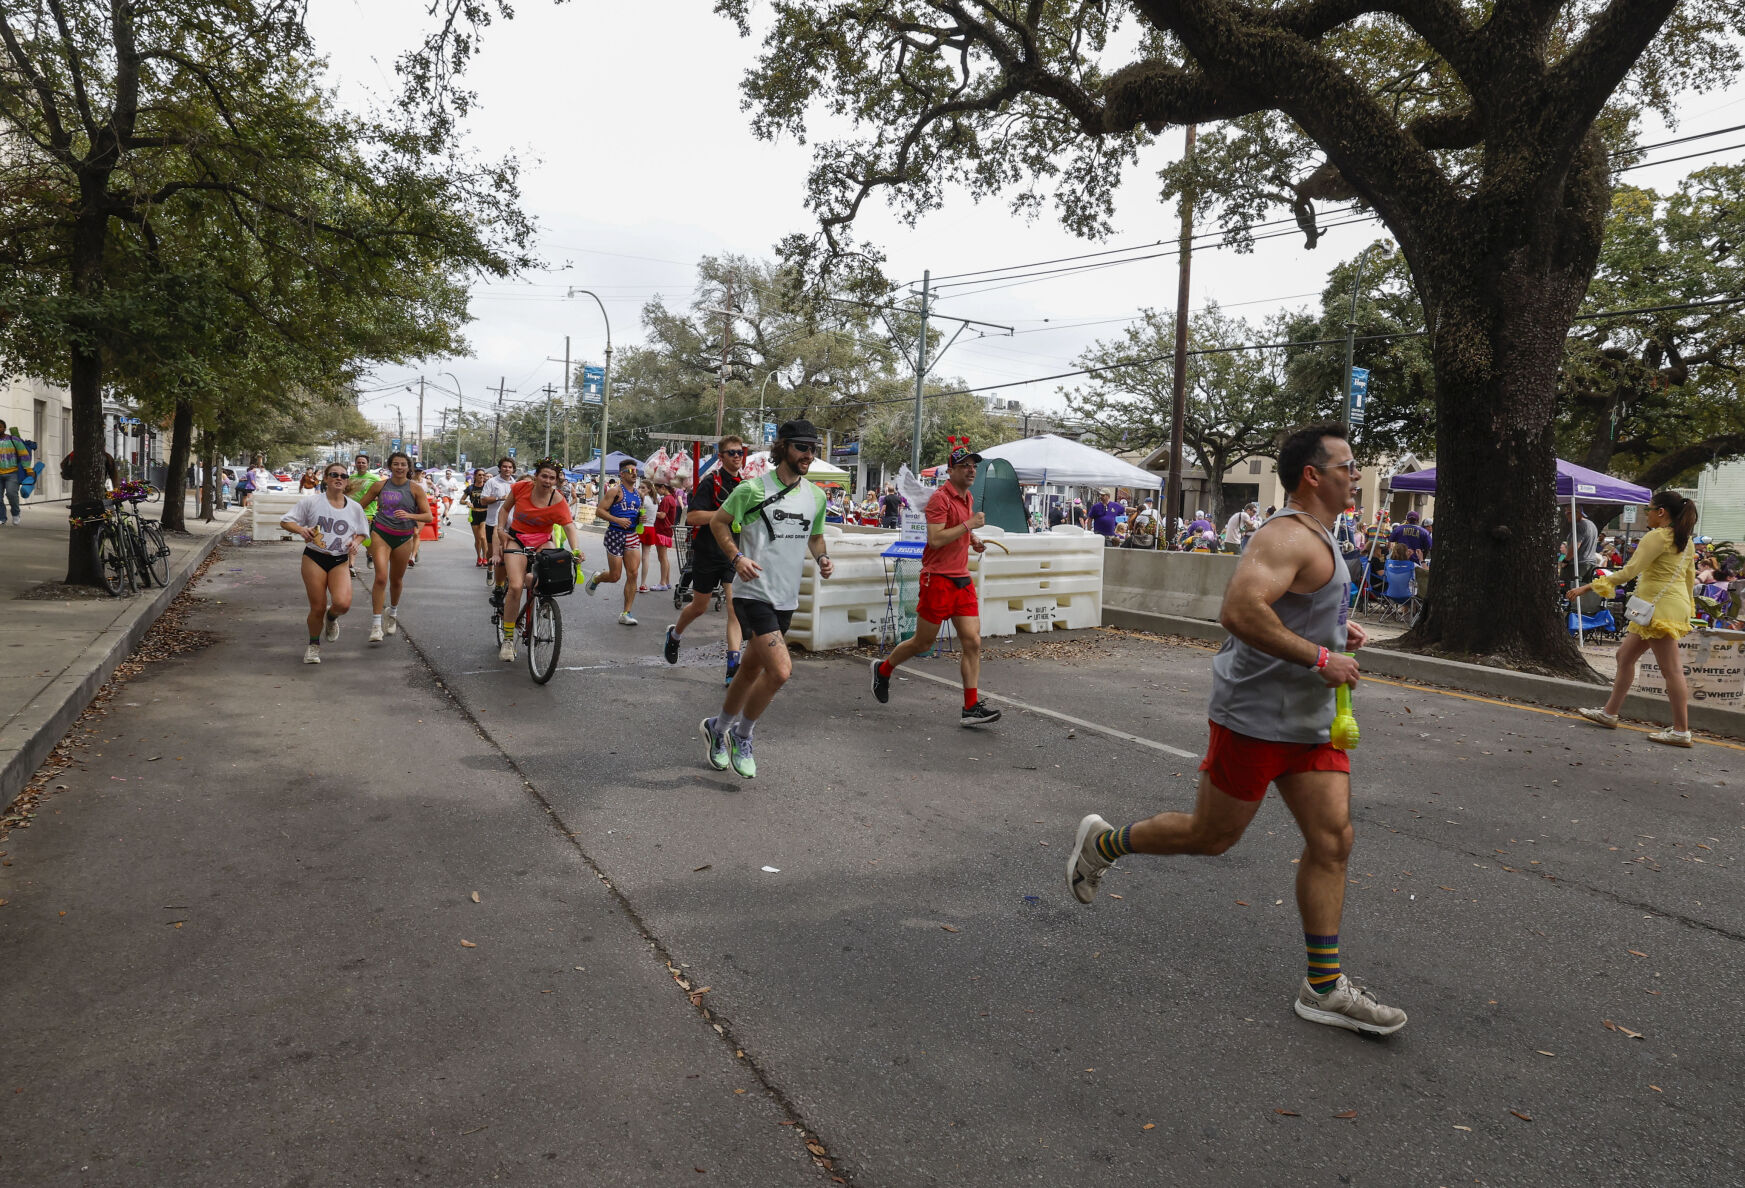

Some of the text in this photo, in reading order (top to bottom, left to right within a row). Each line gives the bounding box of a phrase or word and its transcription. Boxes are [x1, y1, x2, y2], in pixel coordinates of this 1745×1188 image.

[317, 516, 349, 535] NO
[1403, 528, 1420, 538] NOLA
[1641, 686, 1663, 694] WHITE
